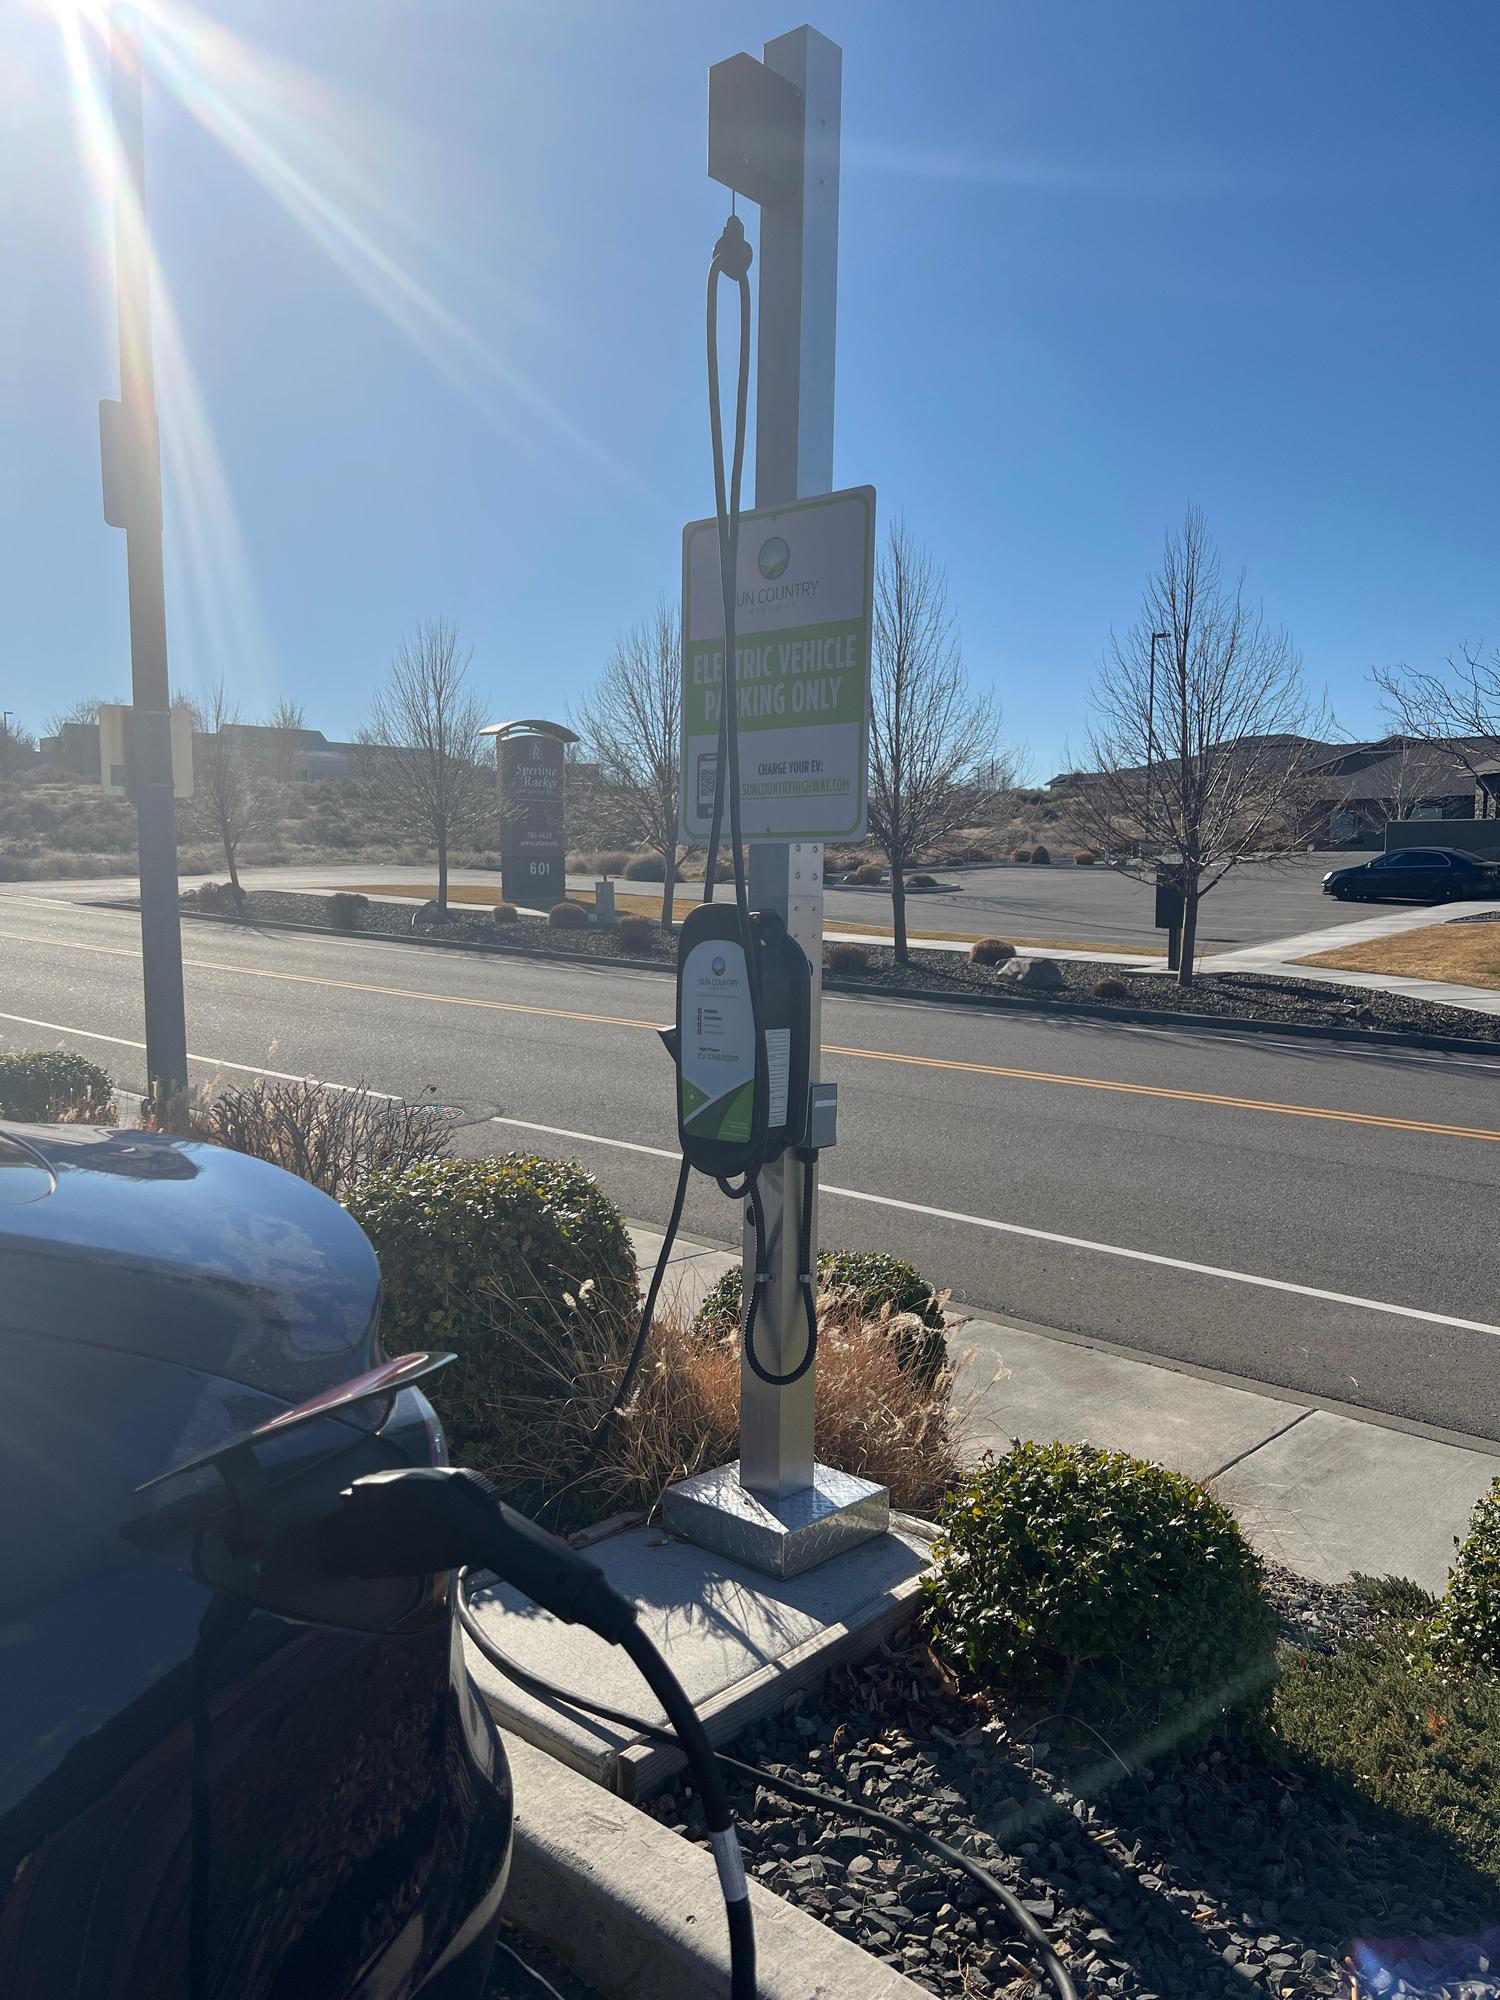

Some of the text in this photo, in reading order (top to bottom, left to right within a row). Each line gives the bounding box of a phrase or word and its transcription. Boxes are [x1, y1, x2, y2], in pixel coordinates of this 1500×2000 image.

[736, 580, 818, 607] UN COUNTRY
[693, 634, 857, 685] ELETRIC VEHICLE
[704, 676, 842, 721] PKING ONLY
[758, 759, 824, 776] CHARGE YOUR EV:
[530, 862, 550, 876] 601
